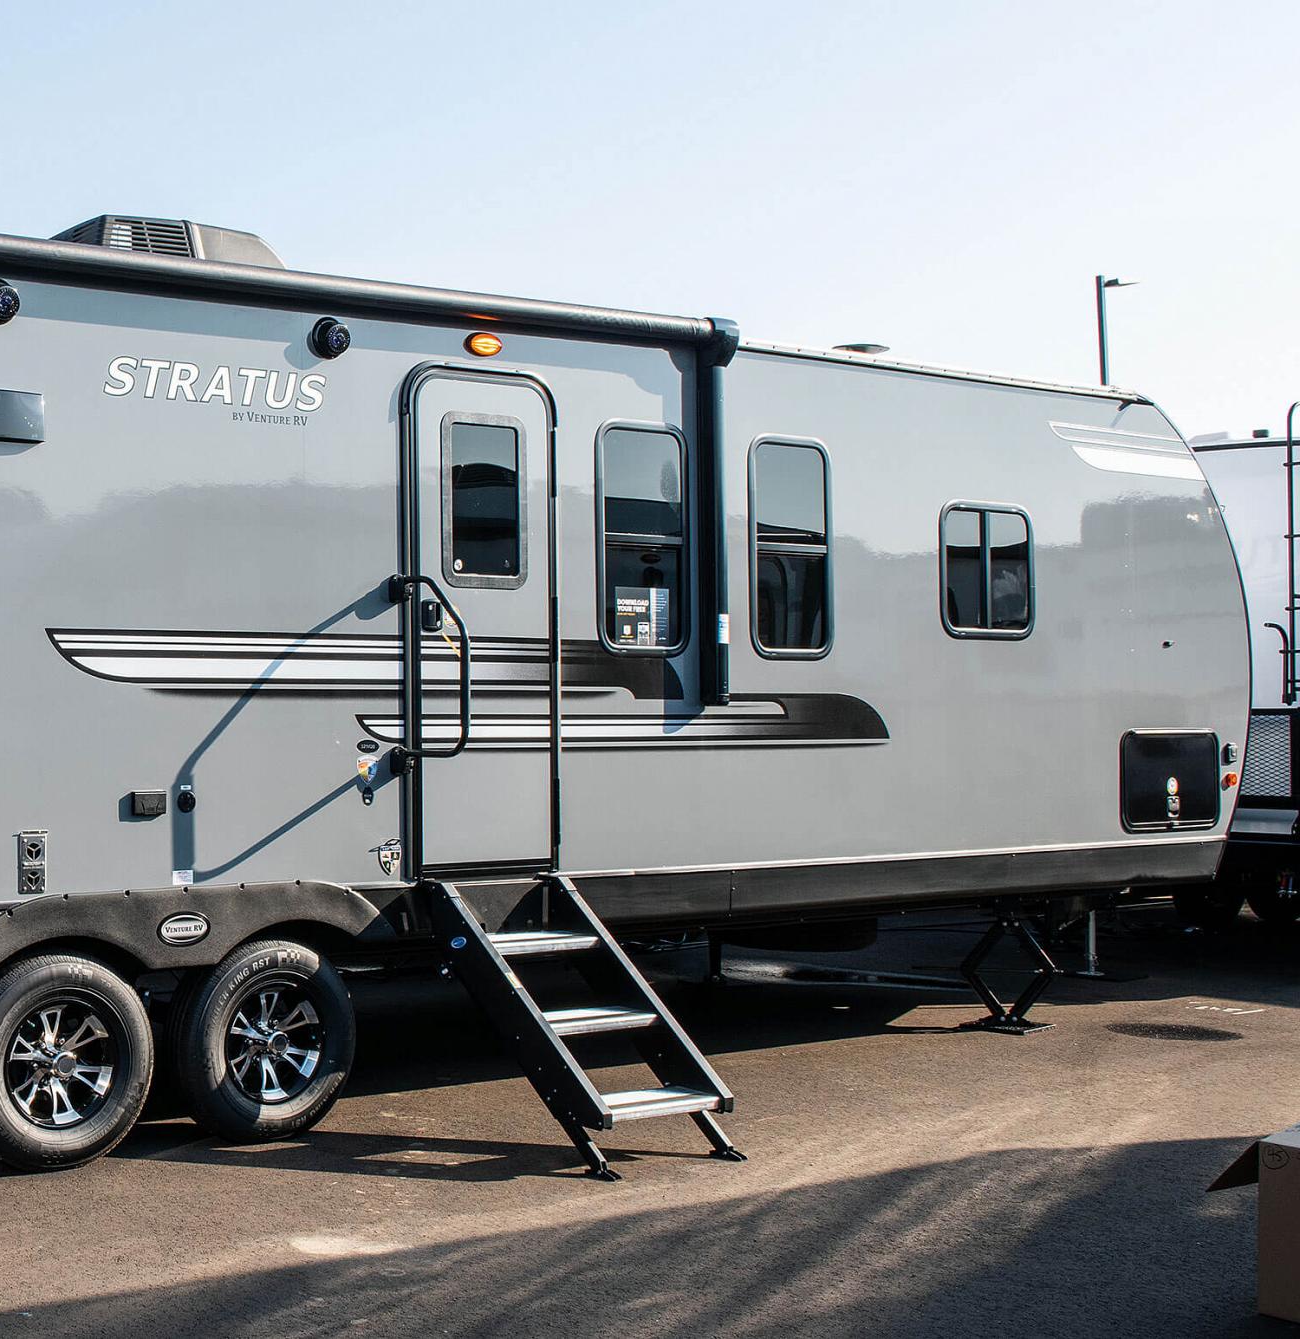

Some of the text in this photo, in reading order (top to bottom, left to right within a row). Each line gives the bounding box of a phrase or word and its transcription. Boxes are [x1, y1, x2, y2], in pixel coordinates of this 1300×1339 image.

[102, 355, 328, 412] STRATUS
[232, 411, 308, 426] BY VENTURE RV
[193, 924, 204, 932] RV
[227, 967, 251, 991] KING
[252, 956, 271, 972] RST
